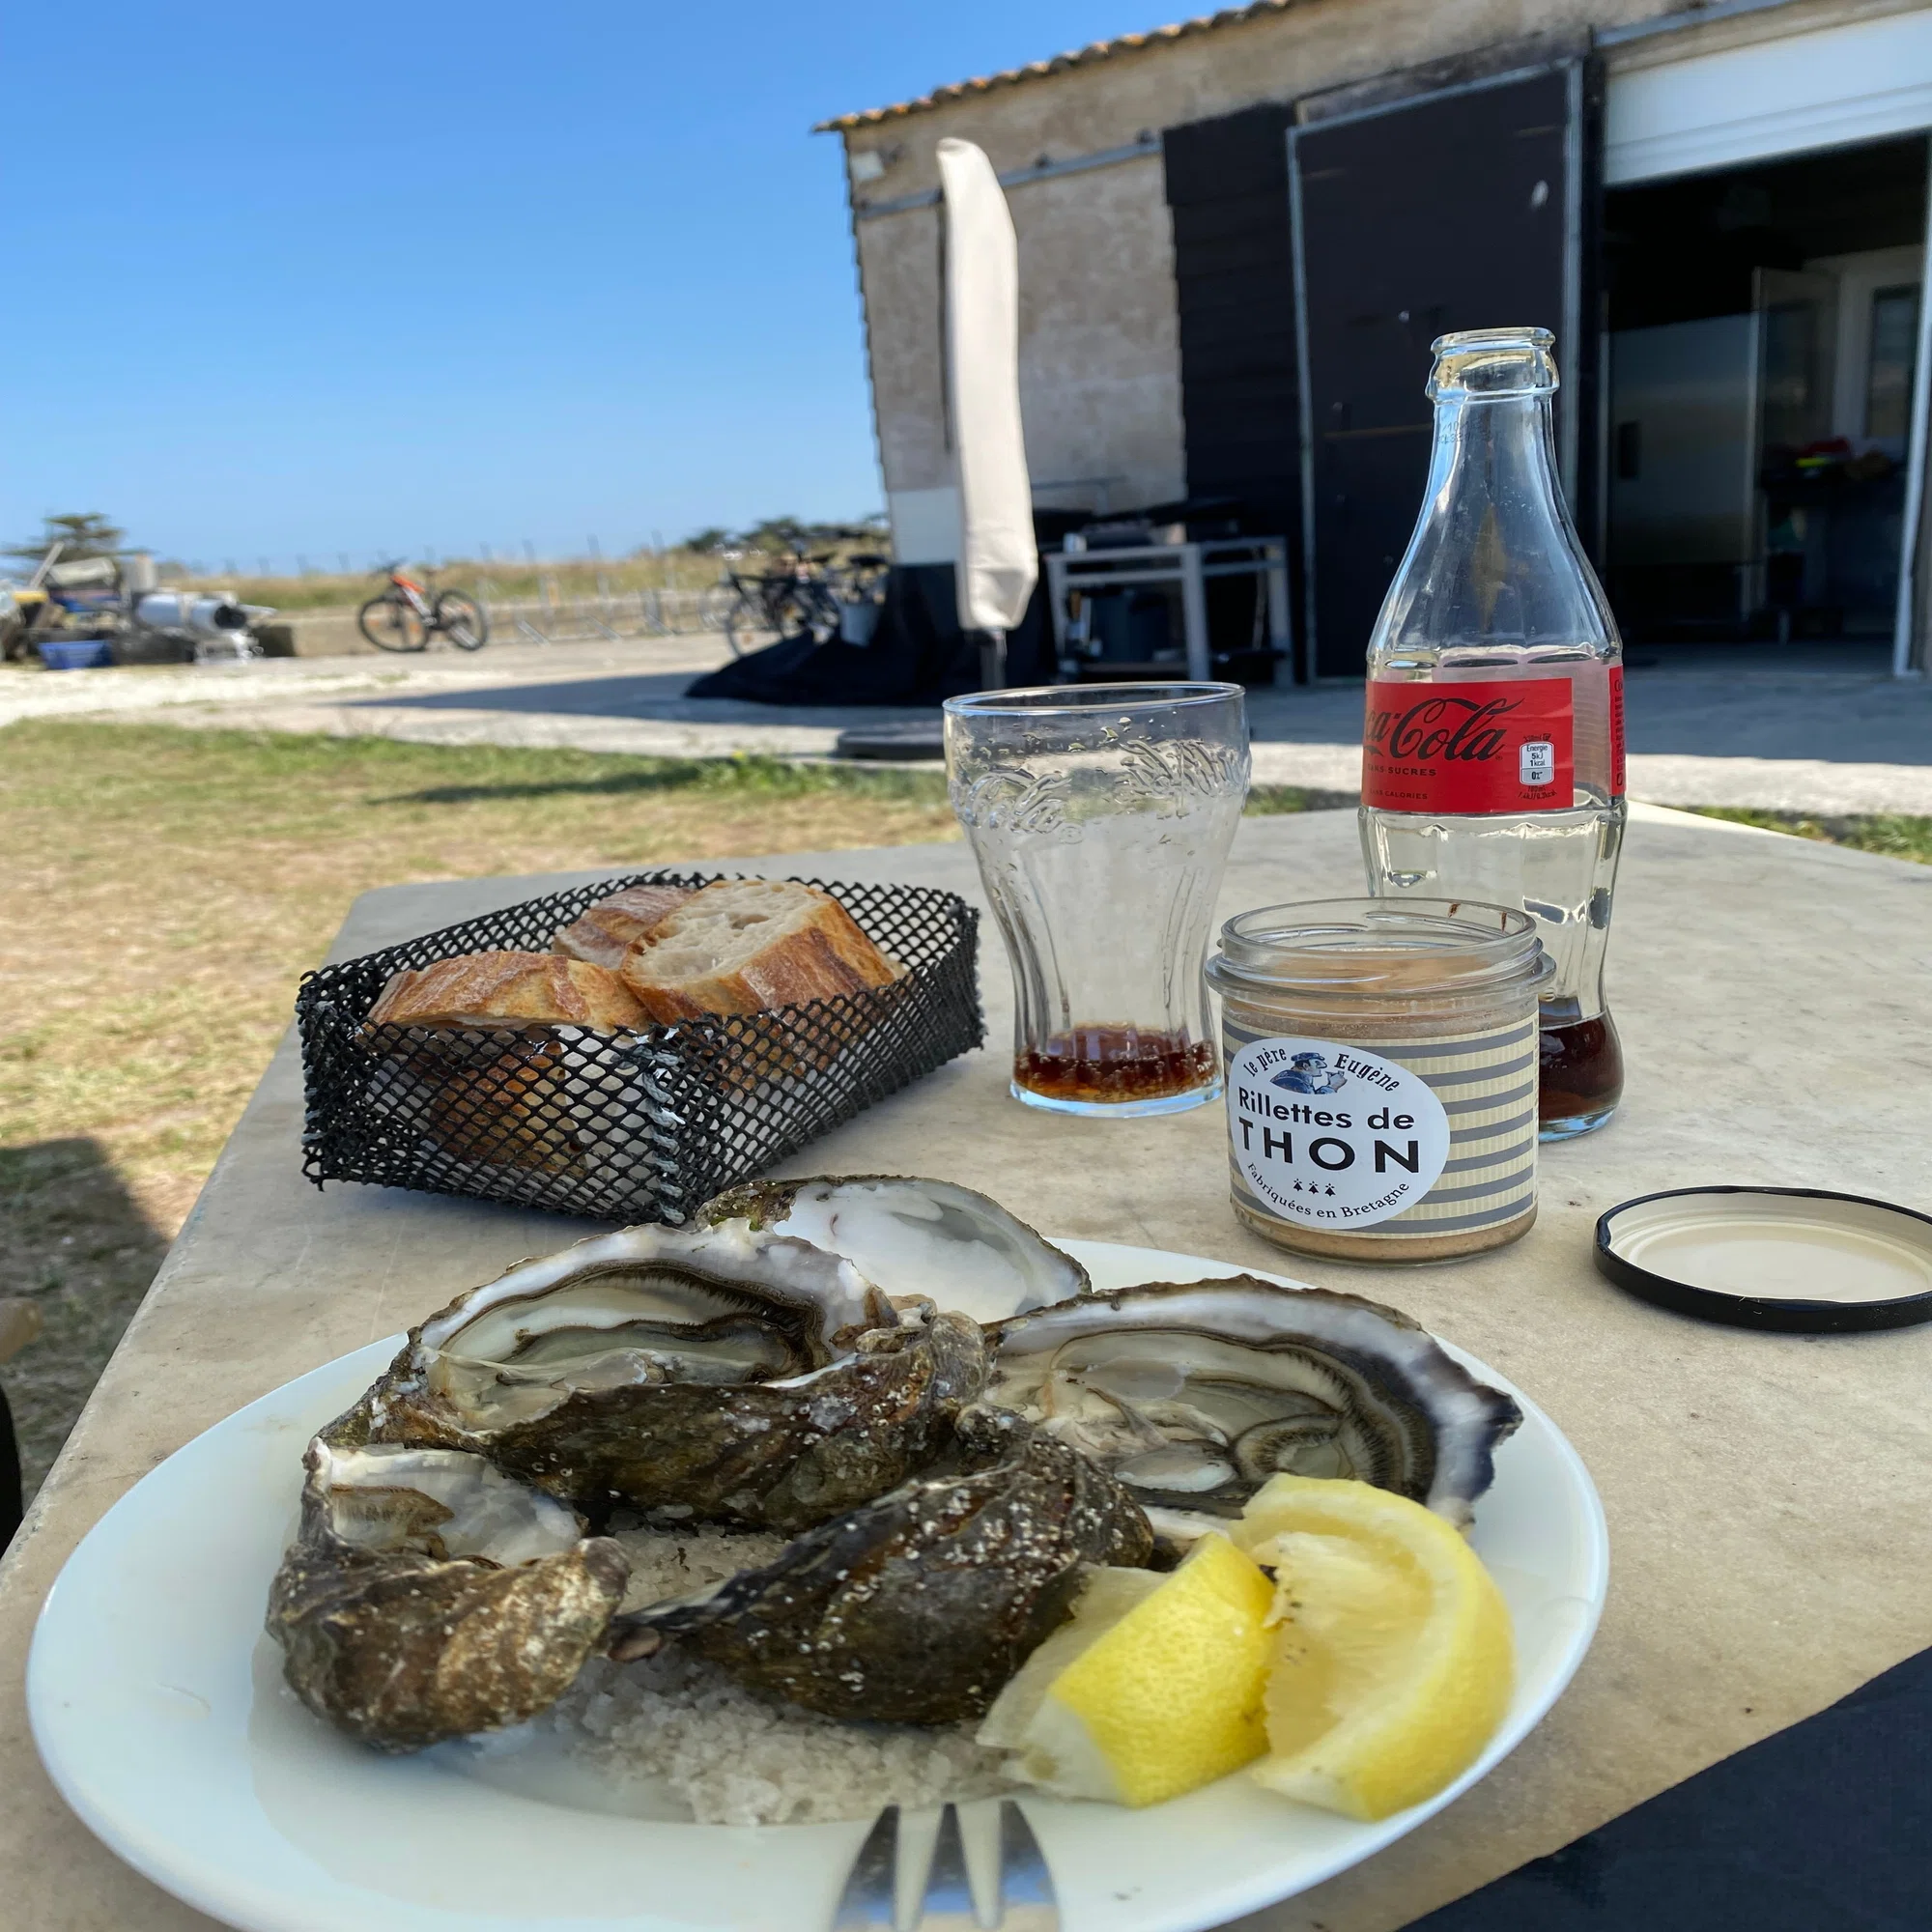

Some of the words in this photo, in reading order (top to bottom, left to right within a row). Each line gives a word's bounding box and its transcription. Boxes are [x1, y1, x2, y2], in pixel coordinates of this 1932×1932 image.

[1363, 697, 1525, 761] ca-Cola
[1388, 766, 1437, 777] SUCRES
[1385, 790, 1428, 800] CALORIES
[1243, 1061, 1258, 1077] le
[1256, 1047, 1288, 1071] père
[1334, 1053, 1401, 1093] Eugène
[1238, 1086, 1352, 1128] Rillettes
[1367, 1107, 1415, 1130] de
[1238, 1116, 1419, 1173] THON
[1247, 1162, 1311, 1216] Fabriquées
[1340, 1182, 1410, 1218] Bretagne
